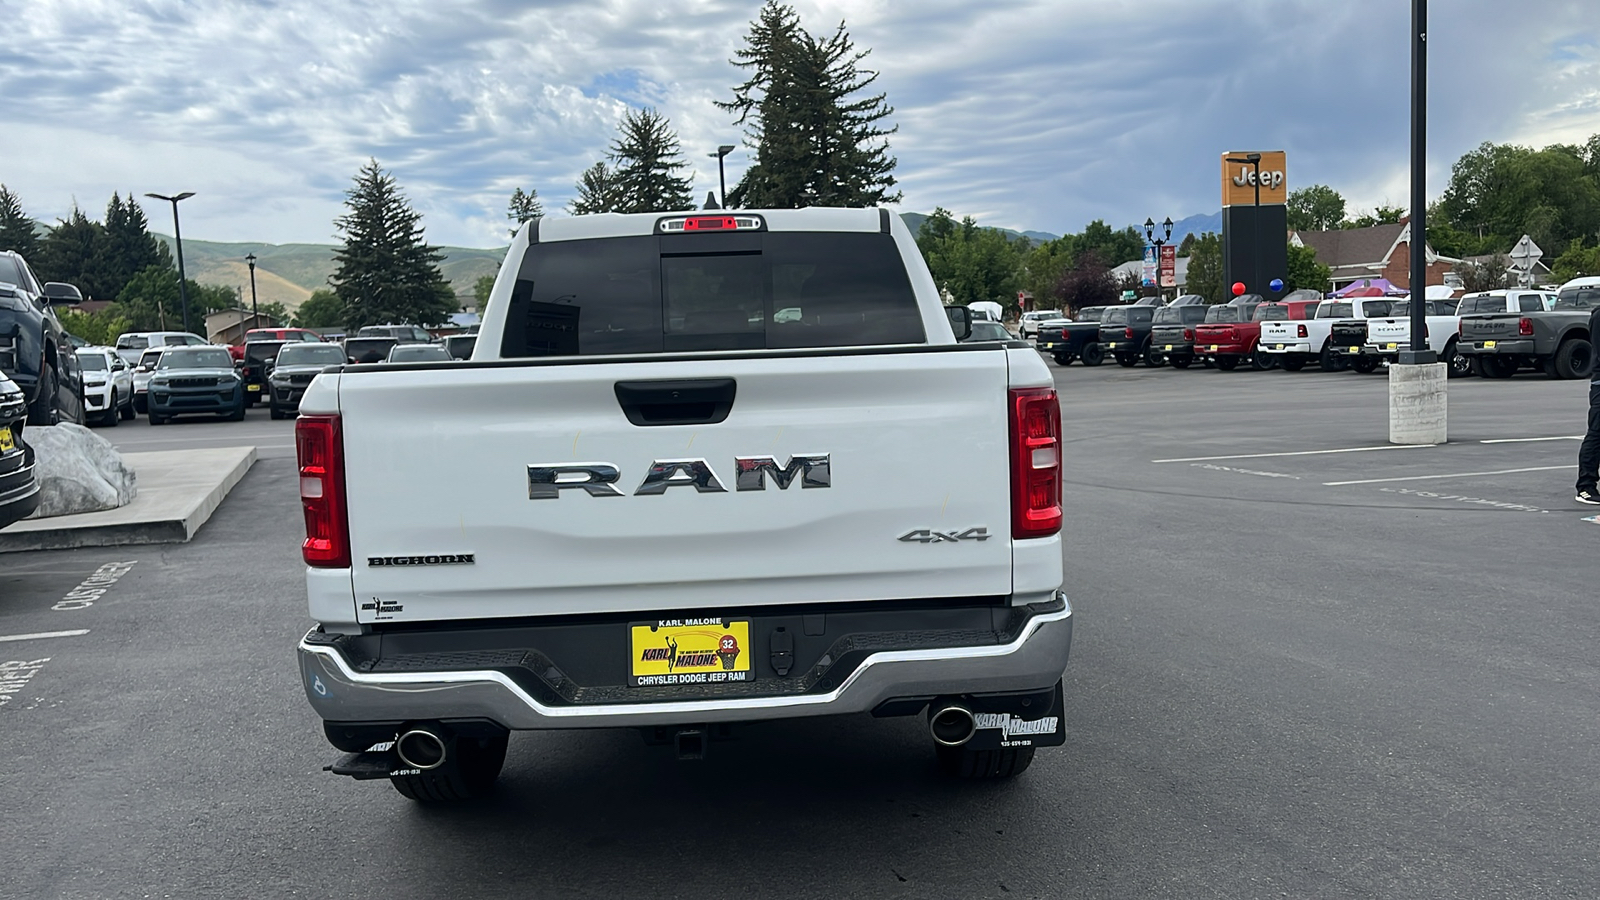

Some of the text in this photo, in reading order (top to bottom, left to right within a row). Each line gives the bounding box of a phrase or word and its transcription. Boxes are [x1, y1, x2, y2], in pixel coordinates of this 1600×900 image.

[1233, 166, 1284, 189] Jeep
[527, 452, 832, 500] RAM
[897, 527, 992, 543] 4x4
[367, 554, 475, 568] BIGHORN
[51, 560, 138, 610] CUSTOMER
[658, 617, 722, 627] KARL MALONE
[722, 639, 734, 650] 32
[641, 648, 670, 661] KARL
[674, 654, 718, 668] MALONE
[638, 672, 746, 685] CHRYSLER DODGE JEEP RAM
[974, 712, 1002, 729] KARL
[1008, 717, 1058, 735] MALONE
